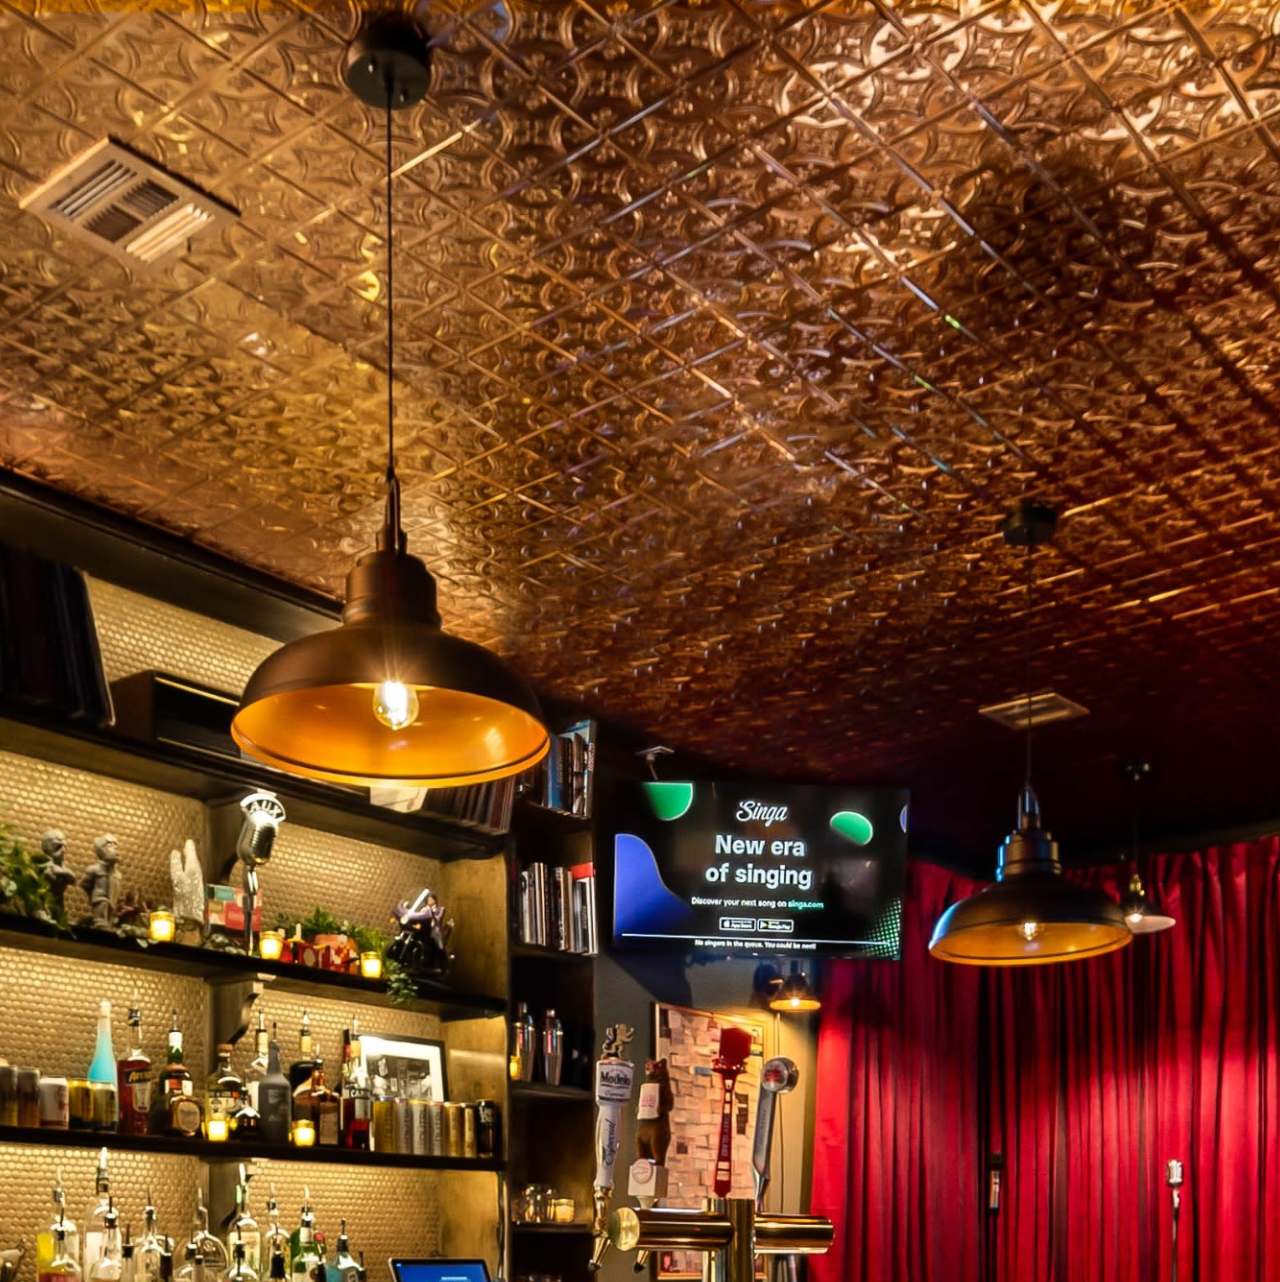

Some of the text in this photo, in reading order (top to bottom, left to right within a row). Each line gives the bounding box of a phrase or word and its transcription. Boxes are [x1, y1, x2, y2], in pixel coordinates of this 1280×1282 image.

[249, 800, 281, 819] AUX
[736, 800, 788, 827] Singa
[715, 834, 805, 857] New era
[705, 862, 812, 890] of singing
[691, 896, 722, 906] Discover
[723, 898, 740, 907] your
[741, 899, 757, 907] next
[758, 900, 776, 909] song
[788, 899, 824, 910] singa.com
